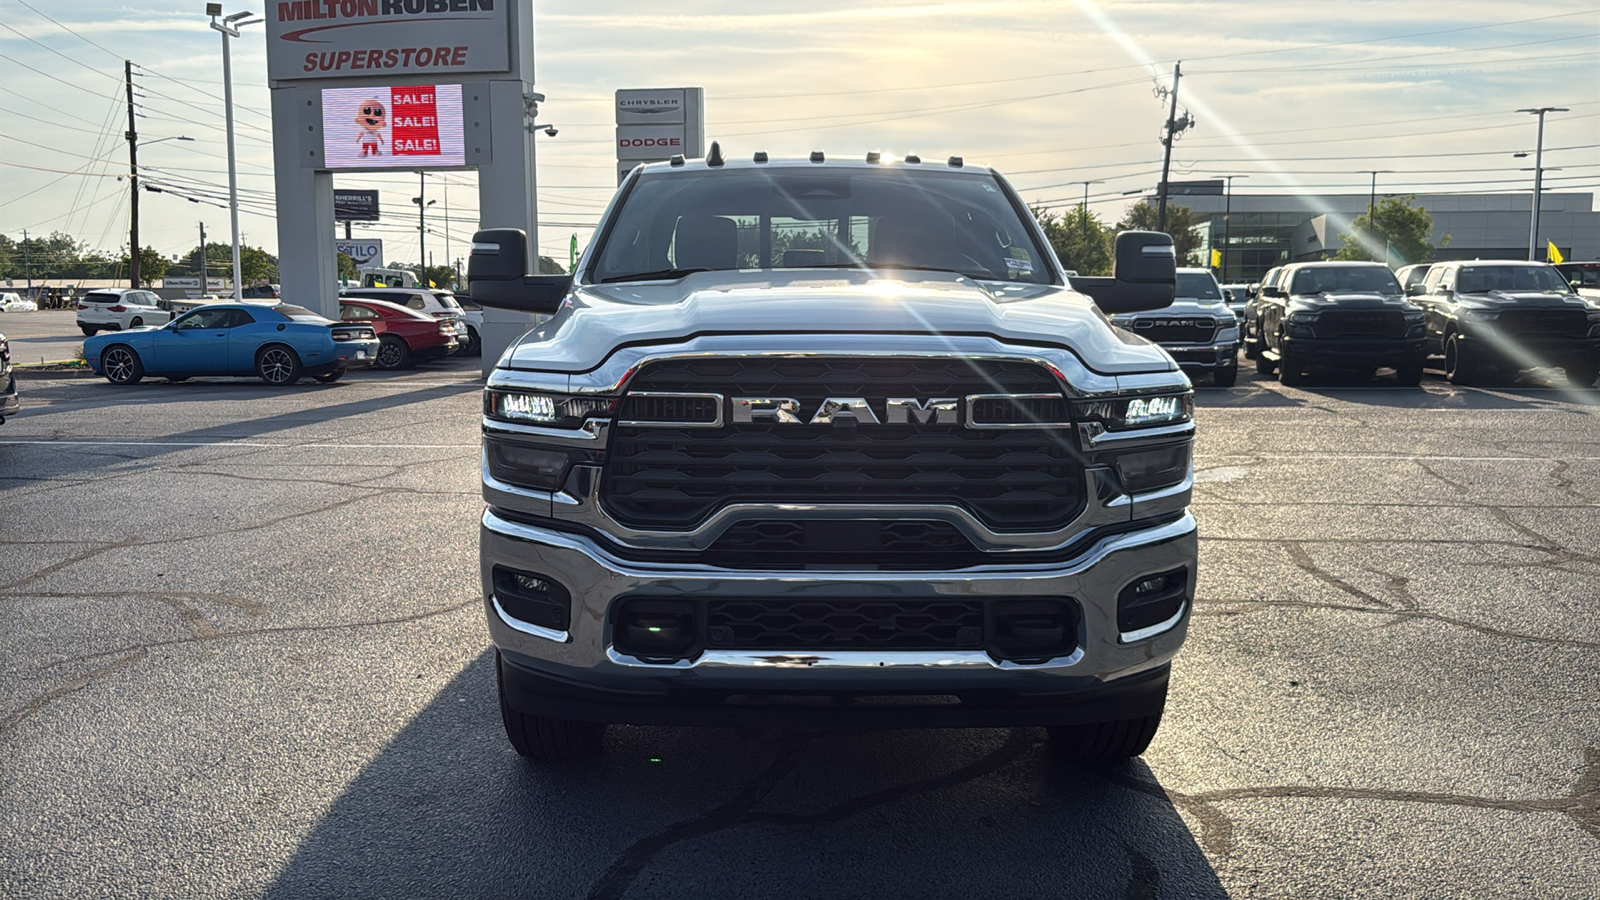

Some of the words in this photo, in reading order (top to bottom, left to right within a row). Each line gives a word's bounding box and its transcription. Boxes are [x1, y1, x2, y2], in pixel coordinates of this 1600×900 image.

[278, 0, 379, 22] MILTON
[381, 0, 494, 15] RUBEN
[303, 46, 469, 72] SUPERSTORE
[393, 94, 434, 105] SALE!
[394, 116, 435, 127] SALE!
[394, 138, 437, 151] SALE!
[620, 138, 681, 147] DODGE
[731, 396, 959, 425] RAM
